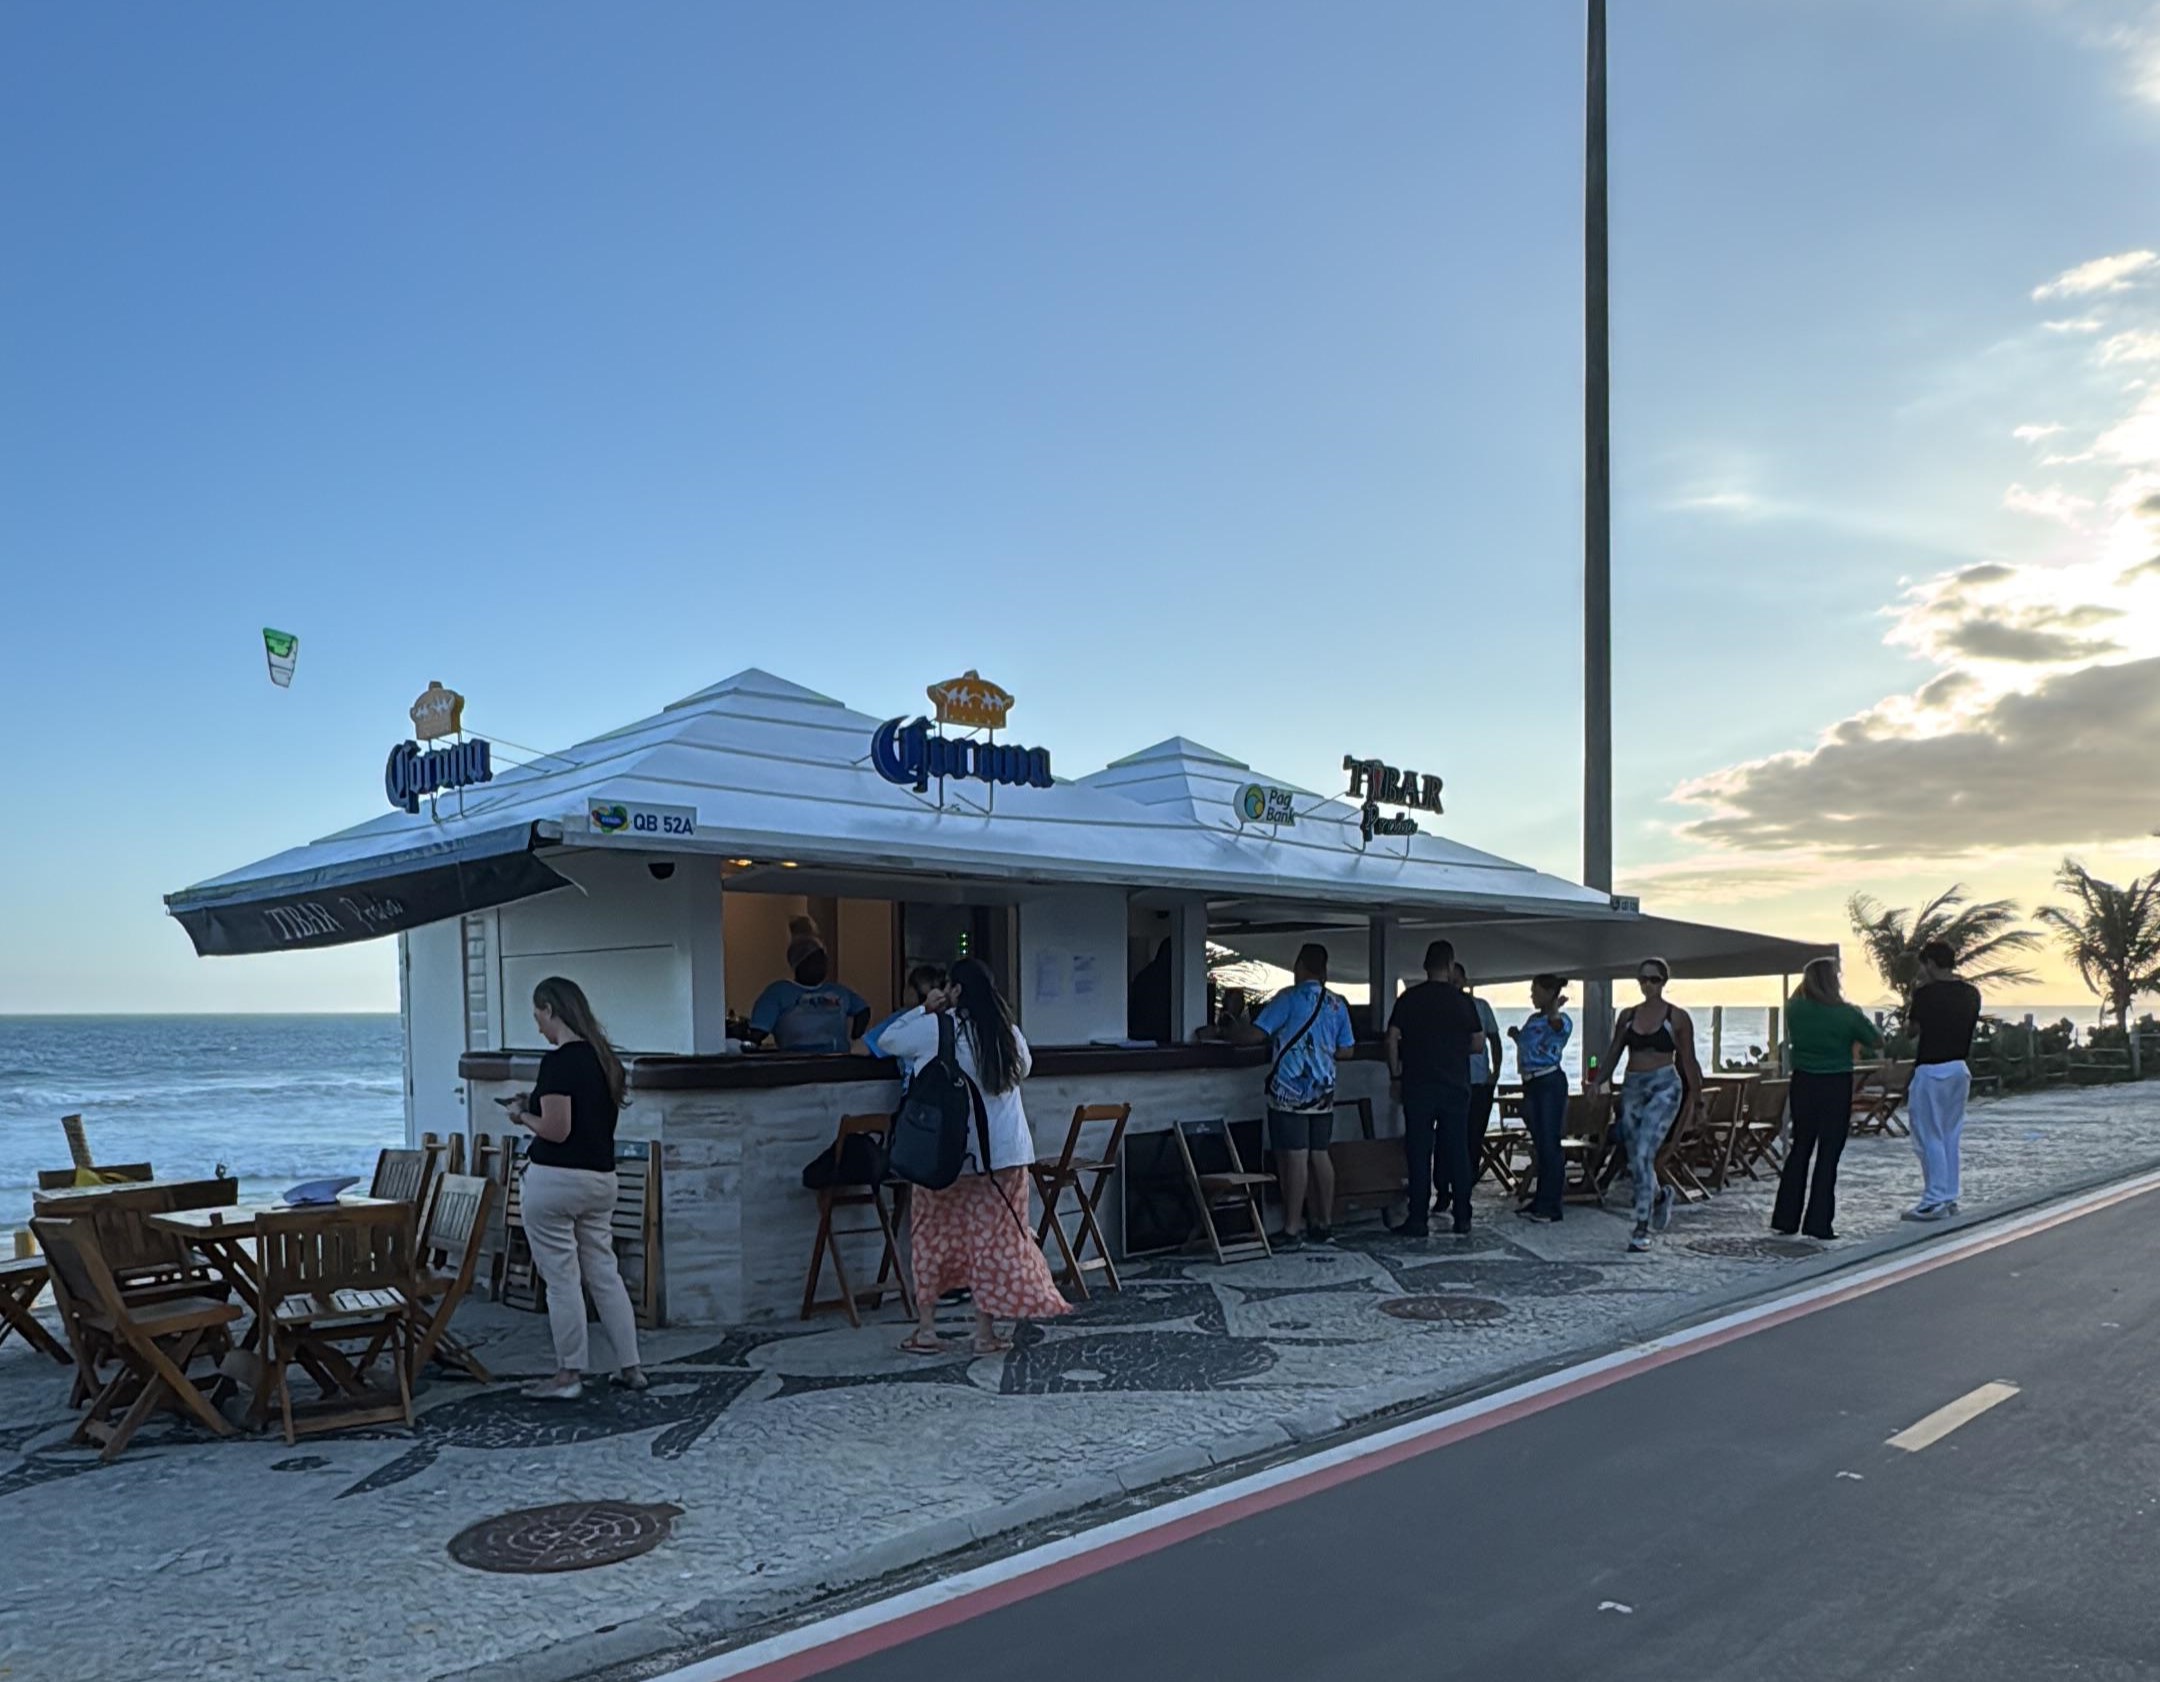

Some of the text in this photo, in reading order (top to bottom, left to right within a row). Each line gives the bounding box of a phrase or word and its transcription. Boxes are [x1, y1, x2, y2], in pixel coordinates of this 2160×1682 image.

[871, 715, 1055, 793] Corona
[385, 739, 493, 814] Corona
[1268, 789, 1292, 811] Pag
[633, 813, 658, 832] QB
[663, 816, 694, 836] 52A
[1266, 805, 1296, 827] Bank
[264, 902, 345, 940] TIBAR
